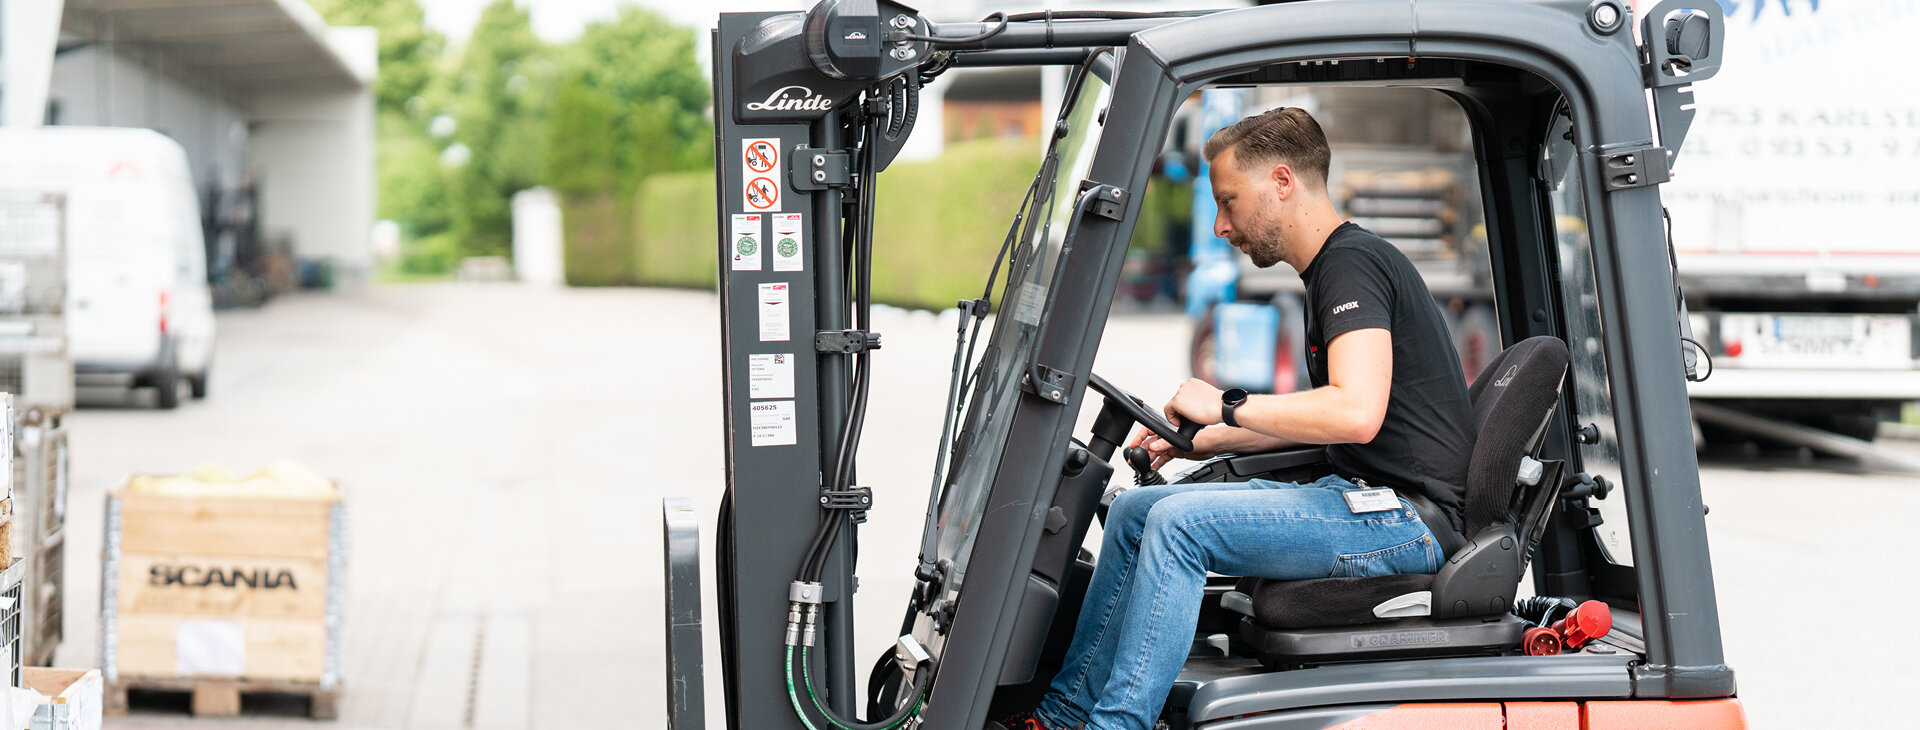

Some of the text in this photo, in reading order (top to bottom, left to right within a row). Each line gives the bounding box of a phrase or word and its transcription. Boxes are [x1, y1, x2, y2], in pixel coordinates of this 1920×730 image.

[747, 85, 832, 111] Linde
[1332, 300, 1360, 315] uvex
[149, 564, 297, 589] SCANIA
[1369, 631, 1447, 646] GRAMMER
